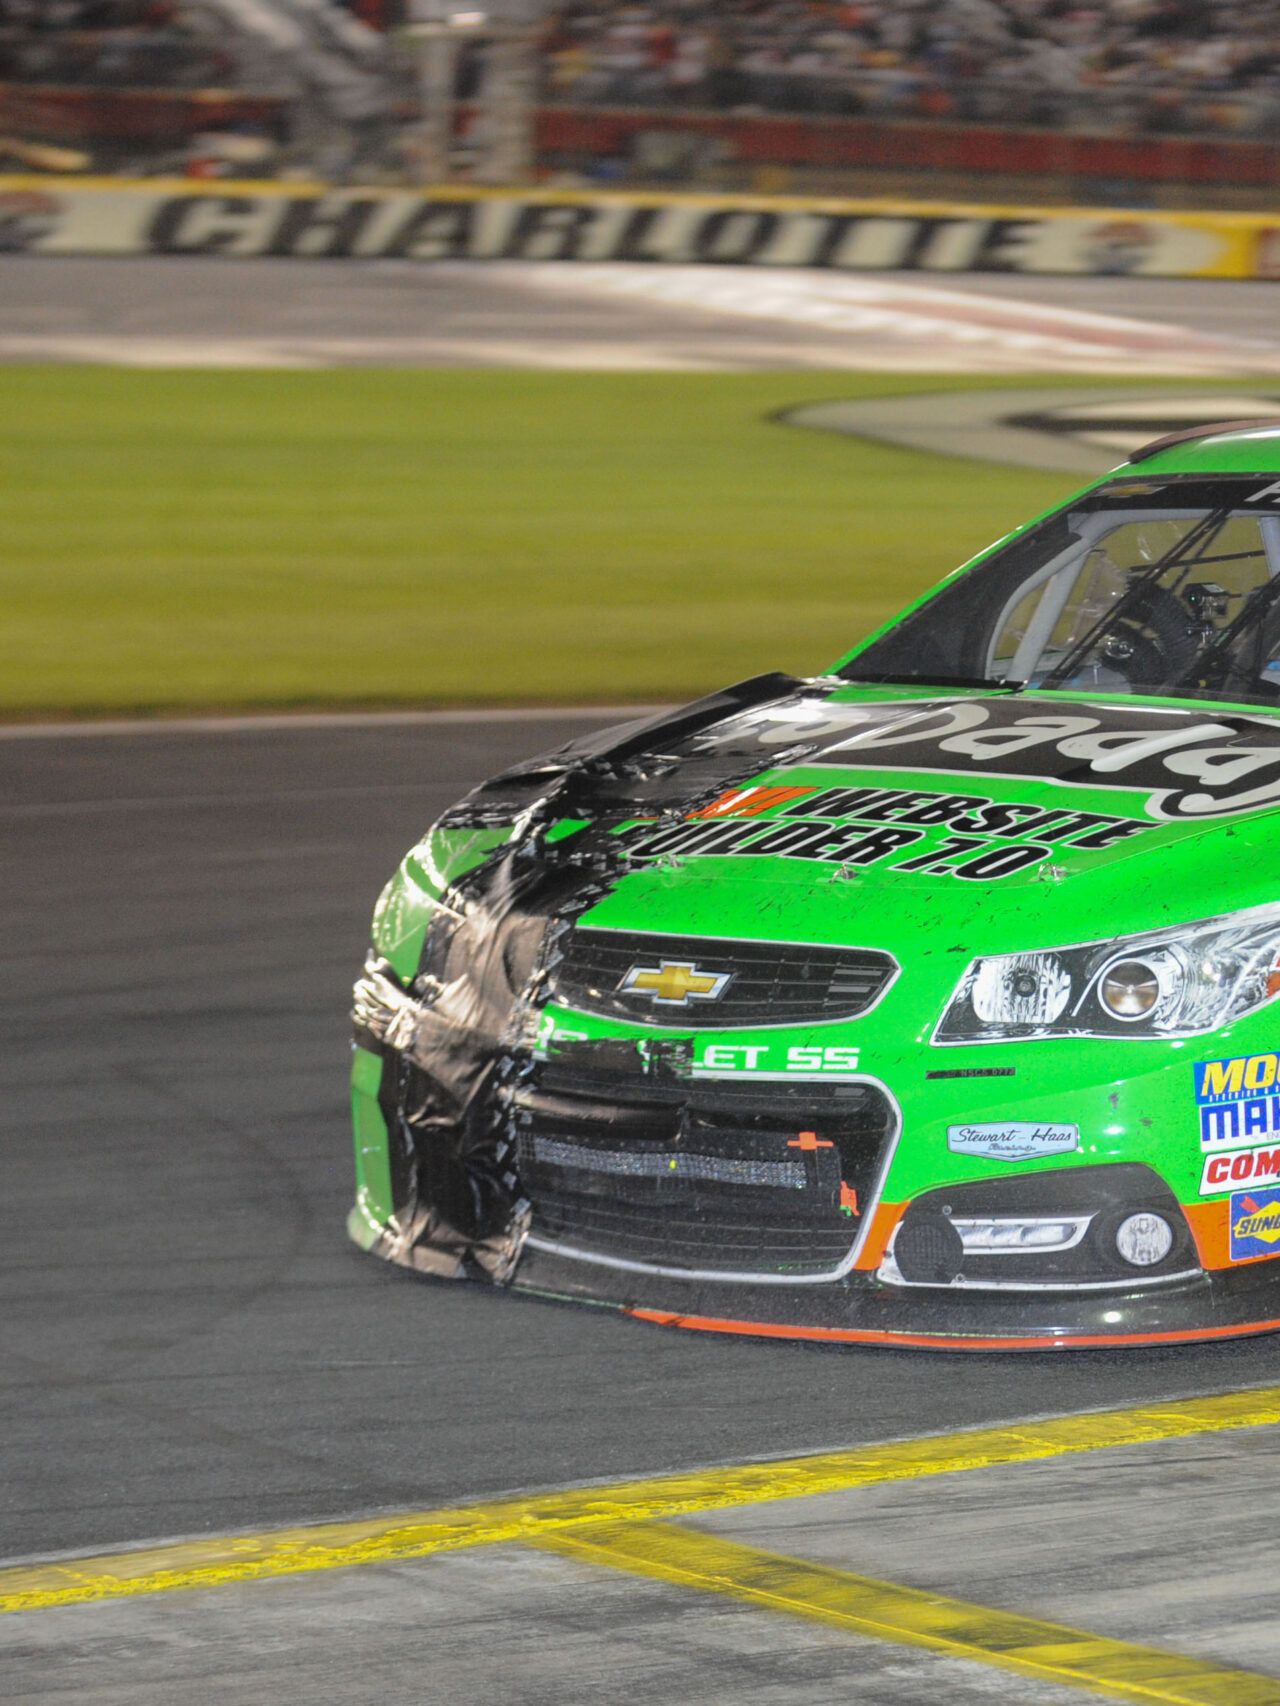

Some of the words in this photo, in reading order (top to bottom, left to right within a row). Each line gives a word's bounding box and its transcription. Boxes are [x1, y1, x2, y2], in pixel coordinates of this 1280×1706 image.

[143, 194, 1045, 272] CHARLOTTE
[618, 820, 926, 866] UILDER
[888, 834, 1053, 880] 7.0
[780, 786, 1165, 851] WEBSITE
